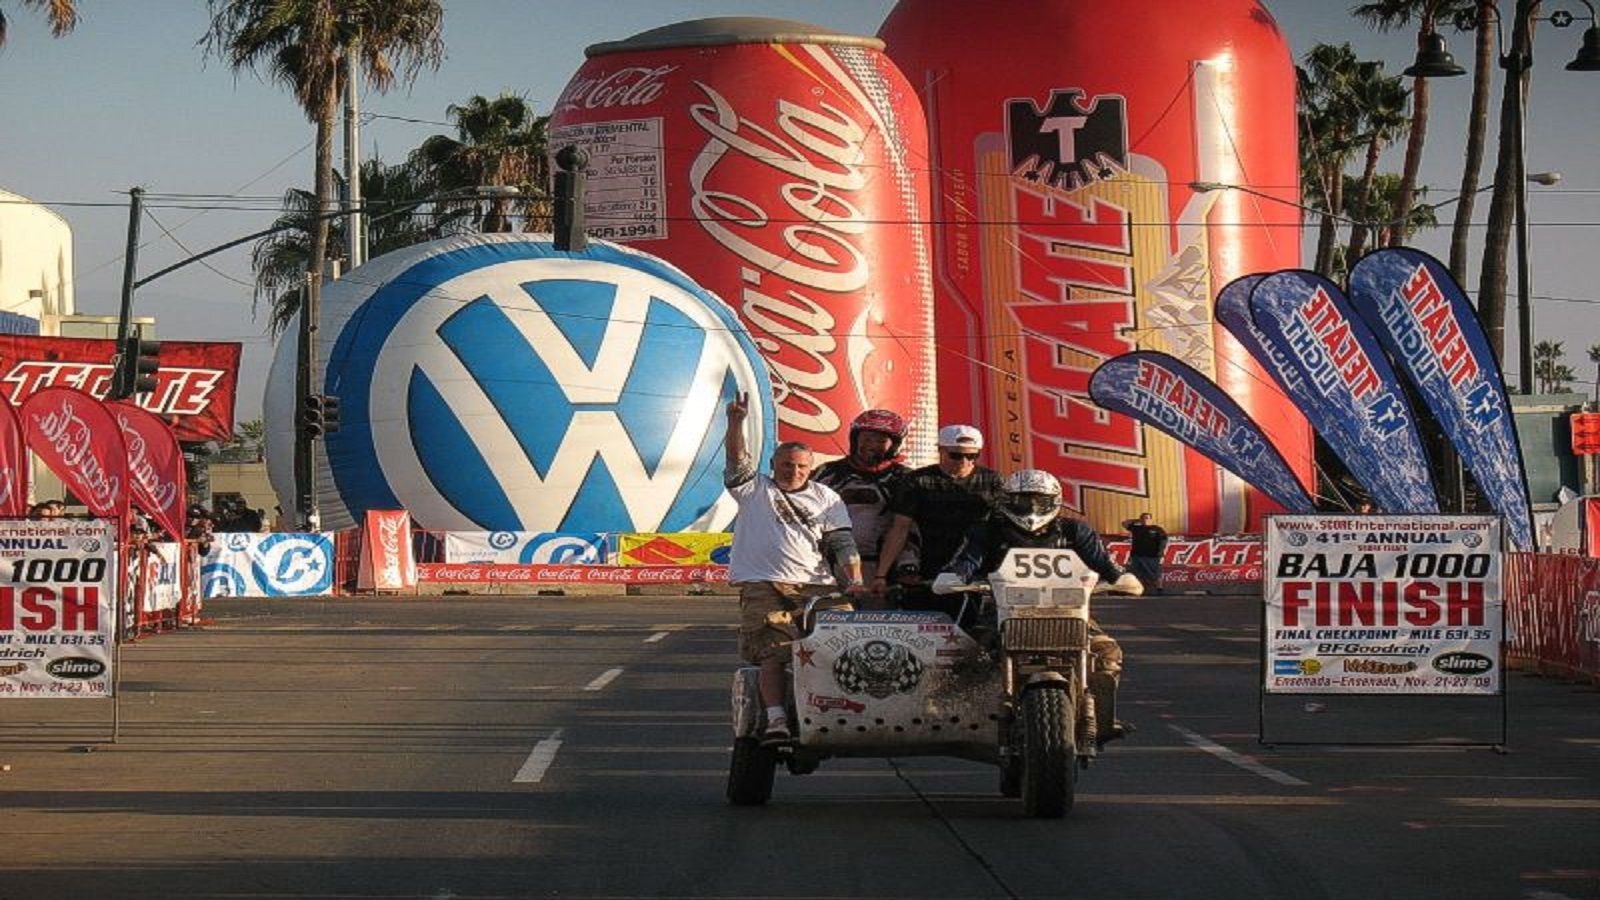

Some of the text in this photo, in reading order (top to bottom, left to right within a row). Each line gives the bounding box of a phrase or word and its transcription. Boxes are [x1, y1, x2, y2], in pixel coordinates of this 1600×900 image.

[3, 361, 225, 415] TECTE
[1316, 533, 1452, 543] 41st ANNUAL
[12, 558, 106, 582] 1000
[1014, 554, 1072, 578] 5SC
[1277, 554, 1378, 578] BAJA
[1395, 554, 1491, 578] 1000
[1282, 582, 1484, 626] FINISH
[24, 635, 57, 644] MILE
[1275, 630, 1312, 640] FINAL
[1316, 630, 1398, 640] CHECKPOINT
[1409, 630, 1441, 640] MILE
[1445, 630, 1491, 640] 631.35
[1317, 643, 1430, 654] BFGoodrich
[52, 660, 101, 673] slime
[1439, 656, 1489, 670] slime
